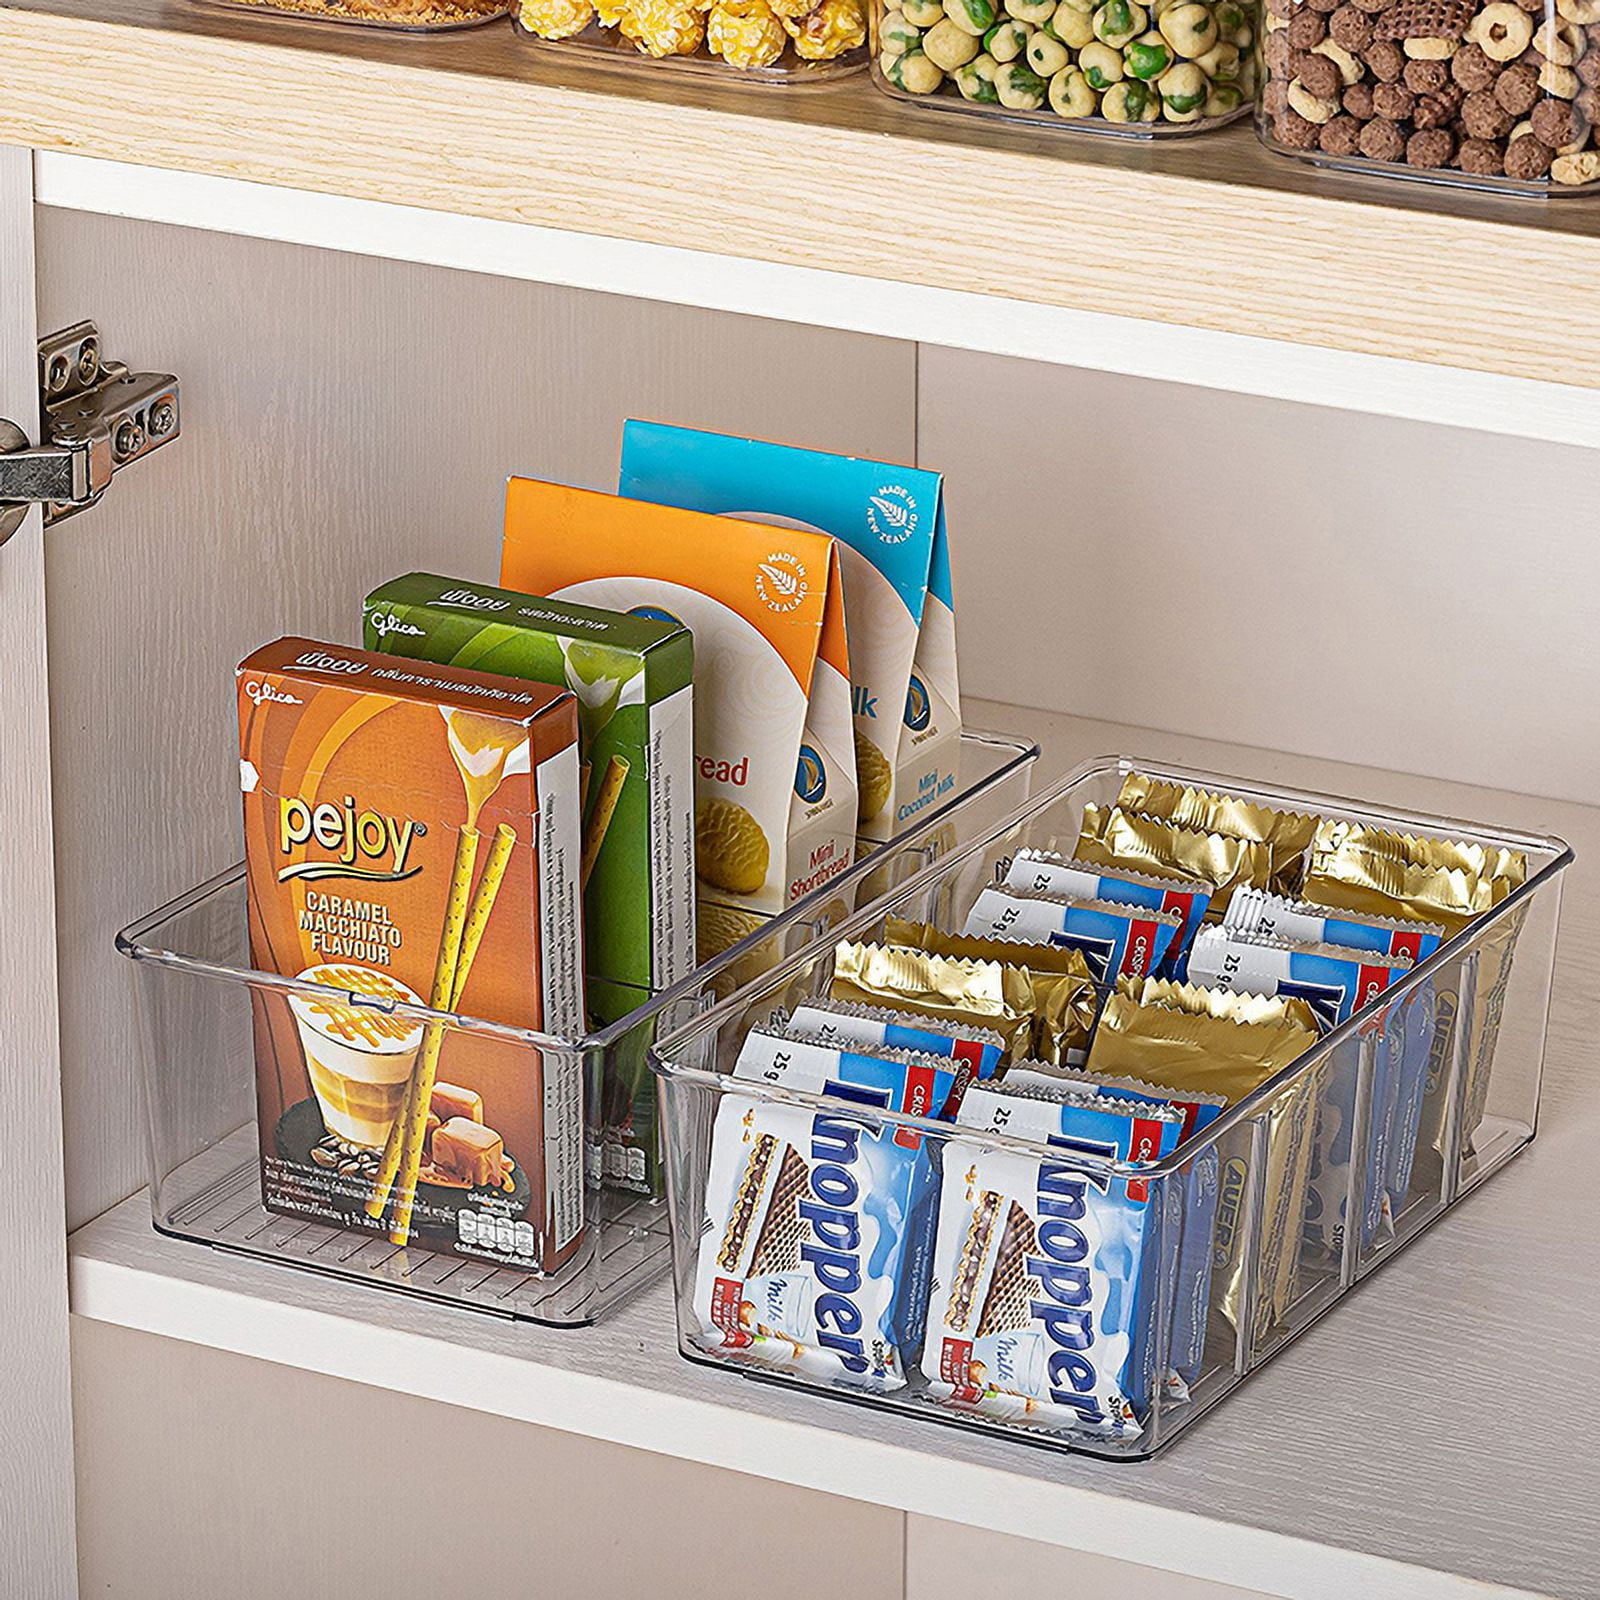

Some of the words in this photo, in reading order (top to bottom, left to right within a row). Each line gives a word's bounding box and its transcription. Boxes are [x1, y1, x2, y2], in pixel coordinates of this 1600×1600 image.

[878, 485, 908, 498] MADE
[905, 495, 917, 509] IN
[867, 507, 880, 534] NEW
[879, 513, 918, 544] ZEALAND
[767, 552, 797, 566] MADE
[795, 563, 807, 577] IN
[755, 574, 768, 601] NEW
[767, 581, 808, 612] ZEALAND
[371, 612, 426, 636] Glico
[245, 682, 303, 706] Glico
[852, 686, 878, 719] lk
[918, 768, 938, 794] Mini
[936, 773, 955, 797] Milk
[279, 795, 414, 873] pejoy
[808, 838, 835, 869] Mini
[789, 847, 851, 900] Shortbread
[1034, 873, 1052, 892] 25
[306, 891, 393, 926] CARAMEL
[299, 909, 403, 949] MACCHIATO
[310, 932, 391, 967] FLAVOUR
[1224, 953, 1241, 973] 25
[772, 1051, 792, 1071] 25
[951, 1056, 973, 1101] CRISPY
[992, 1106, 1011, 1127] 25
